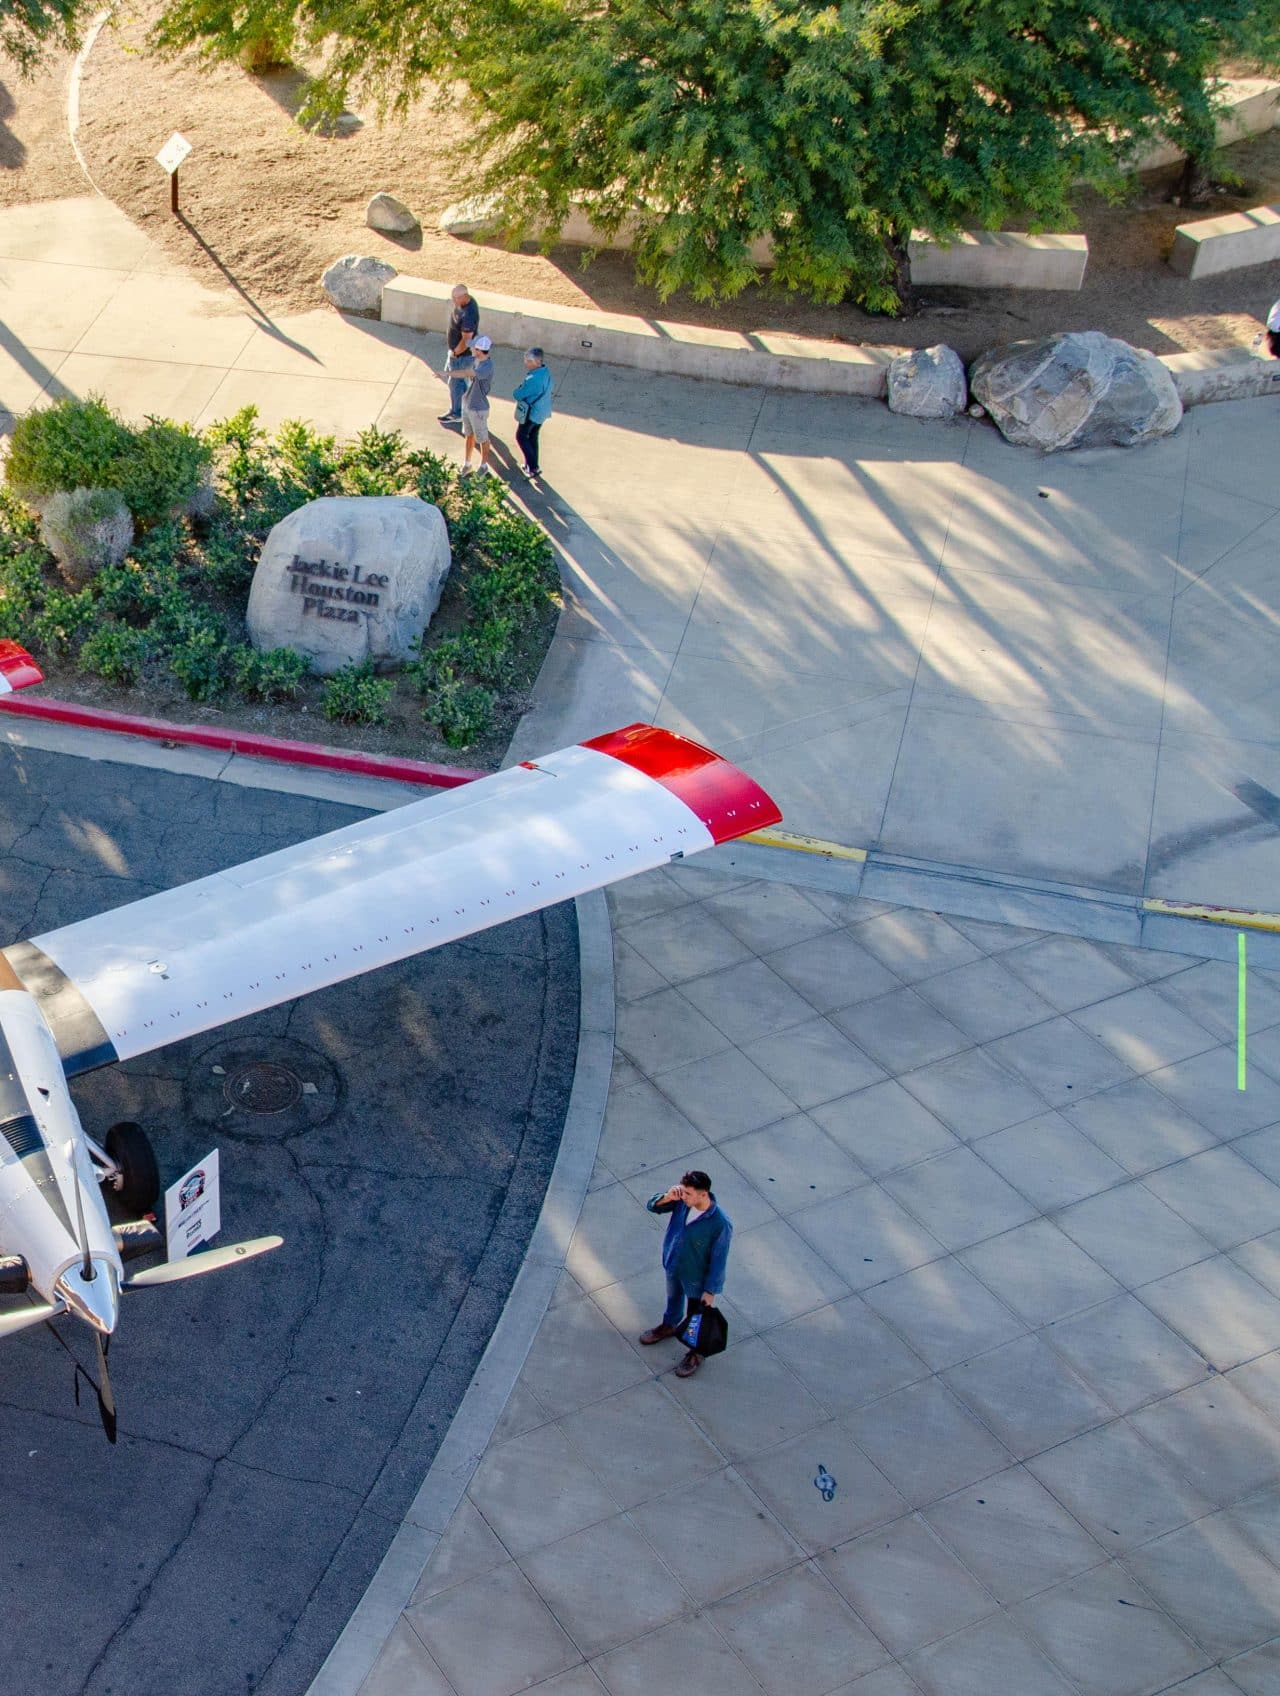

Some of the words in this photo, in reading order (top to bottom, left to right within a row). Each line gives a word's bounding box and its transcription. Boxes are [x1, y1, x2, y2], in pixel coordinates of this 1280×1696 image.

[286, 555, 349, 581] Jackie
[353, 565, 389, 588] Lee
[290, 574, 380, 606] Houston
[303, 598, 359, 623] Plaza
